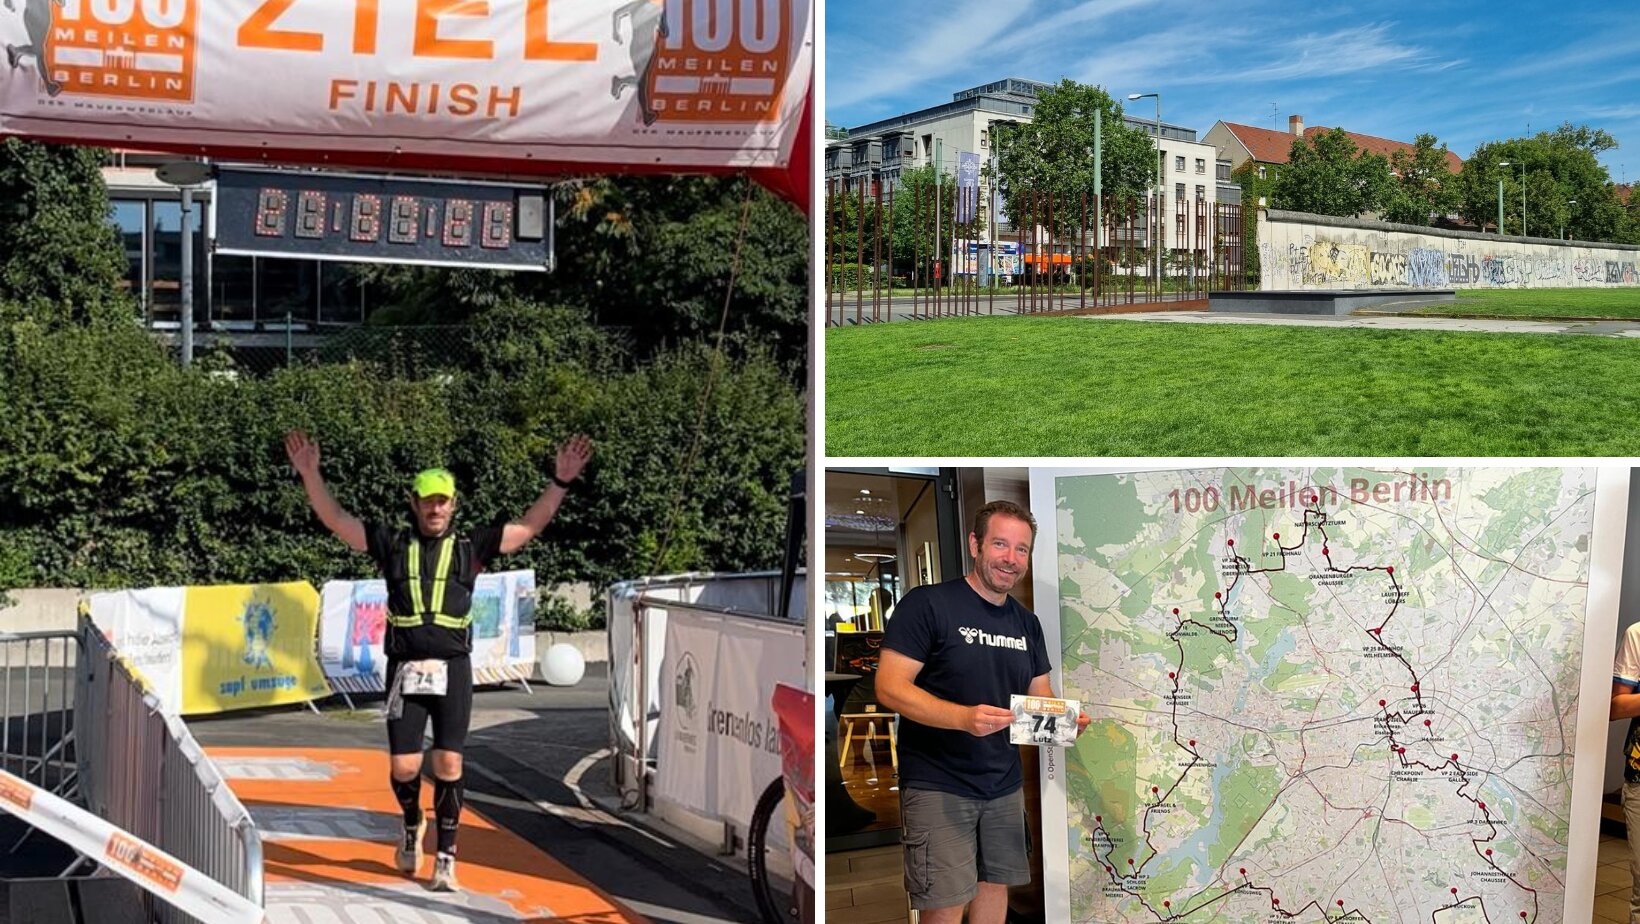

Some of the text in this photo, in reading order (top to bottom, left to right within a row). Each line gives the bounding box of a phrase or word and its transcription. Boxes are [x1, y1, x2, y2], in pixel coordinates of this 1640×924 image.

[55, 28, 185, 49] MEILEN
[237, 0, 600, 62] ZIEL
[658, 57, 777, 73] MEILEN
[54, 70, 183, 91] BERLIN
[329, 79, 521, 118] FINISH
[652, 99, 771, 112] BERLIN
[1168, 472, 1452, 513] 100 Meilen Berlin
[979, 629, 1028, 651] hummel
[1032, 714, 1057, 734] 74
[1033, 735, 1053, 744] Lutz
